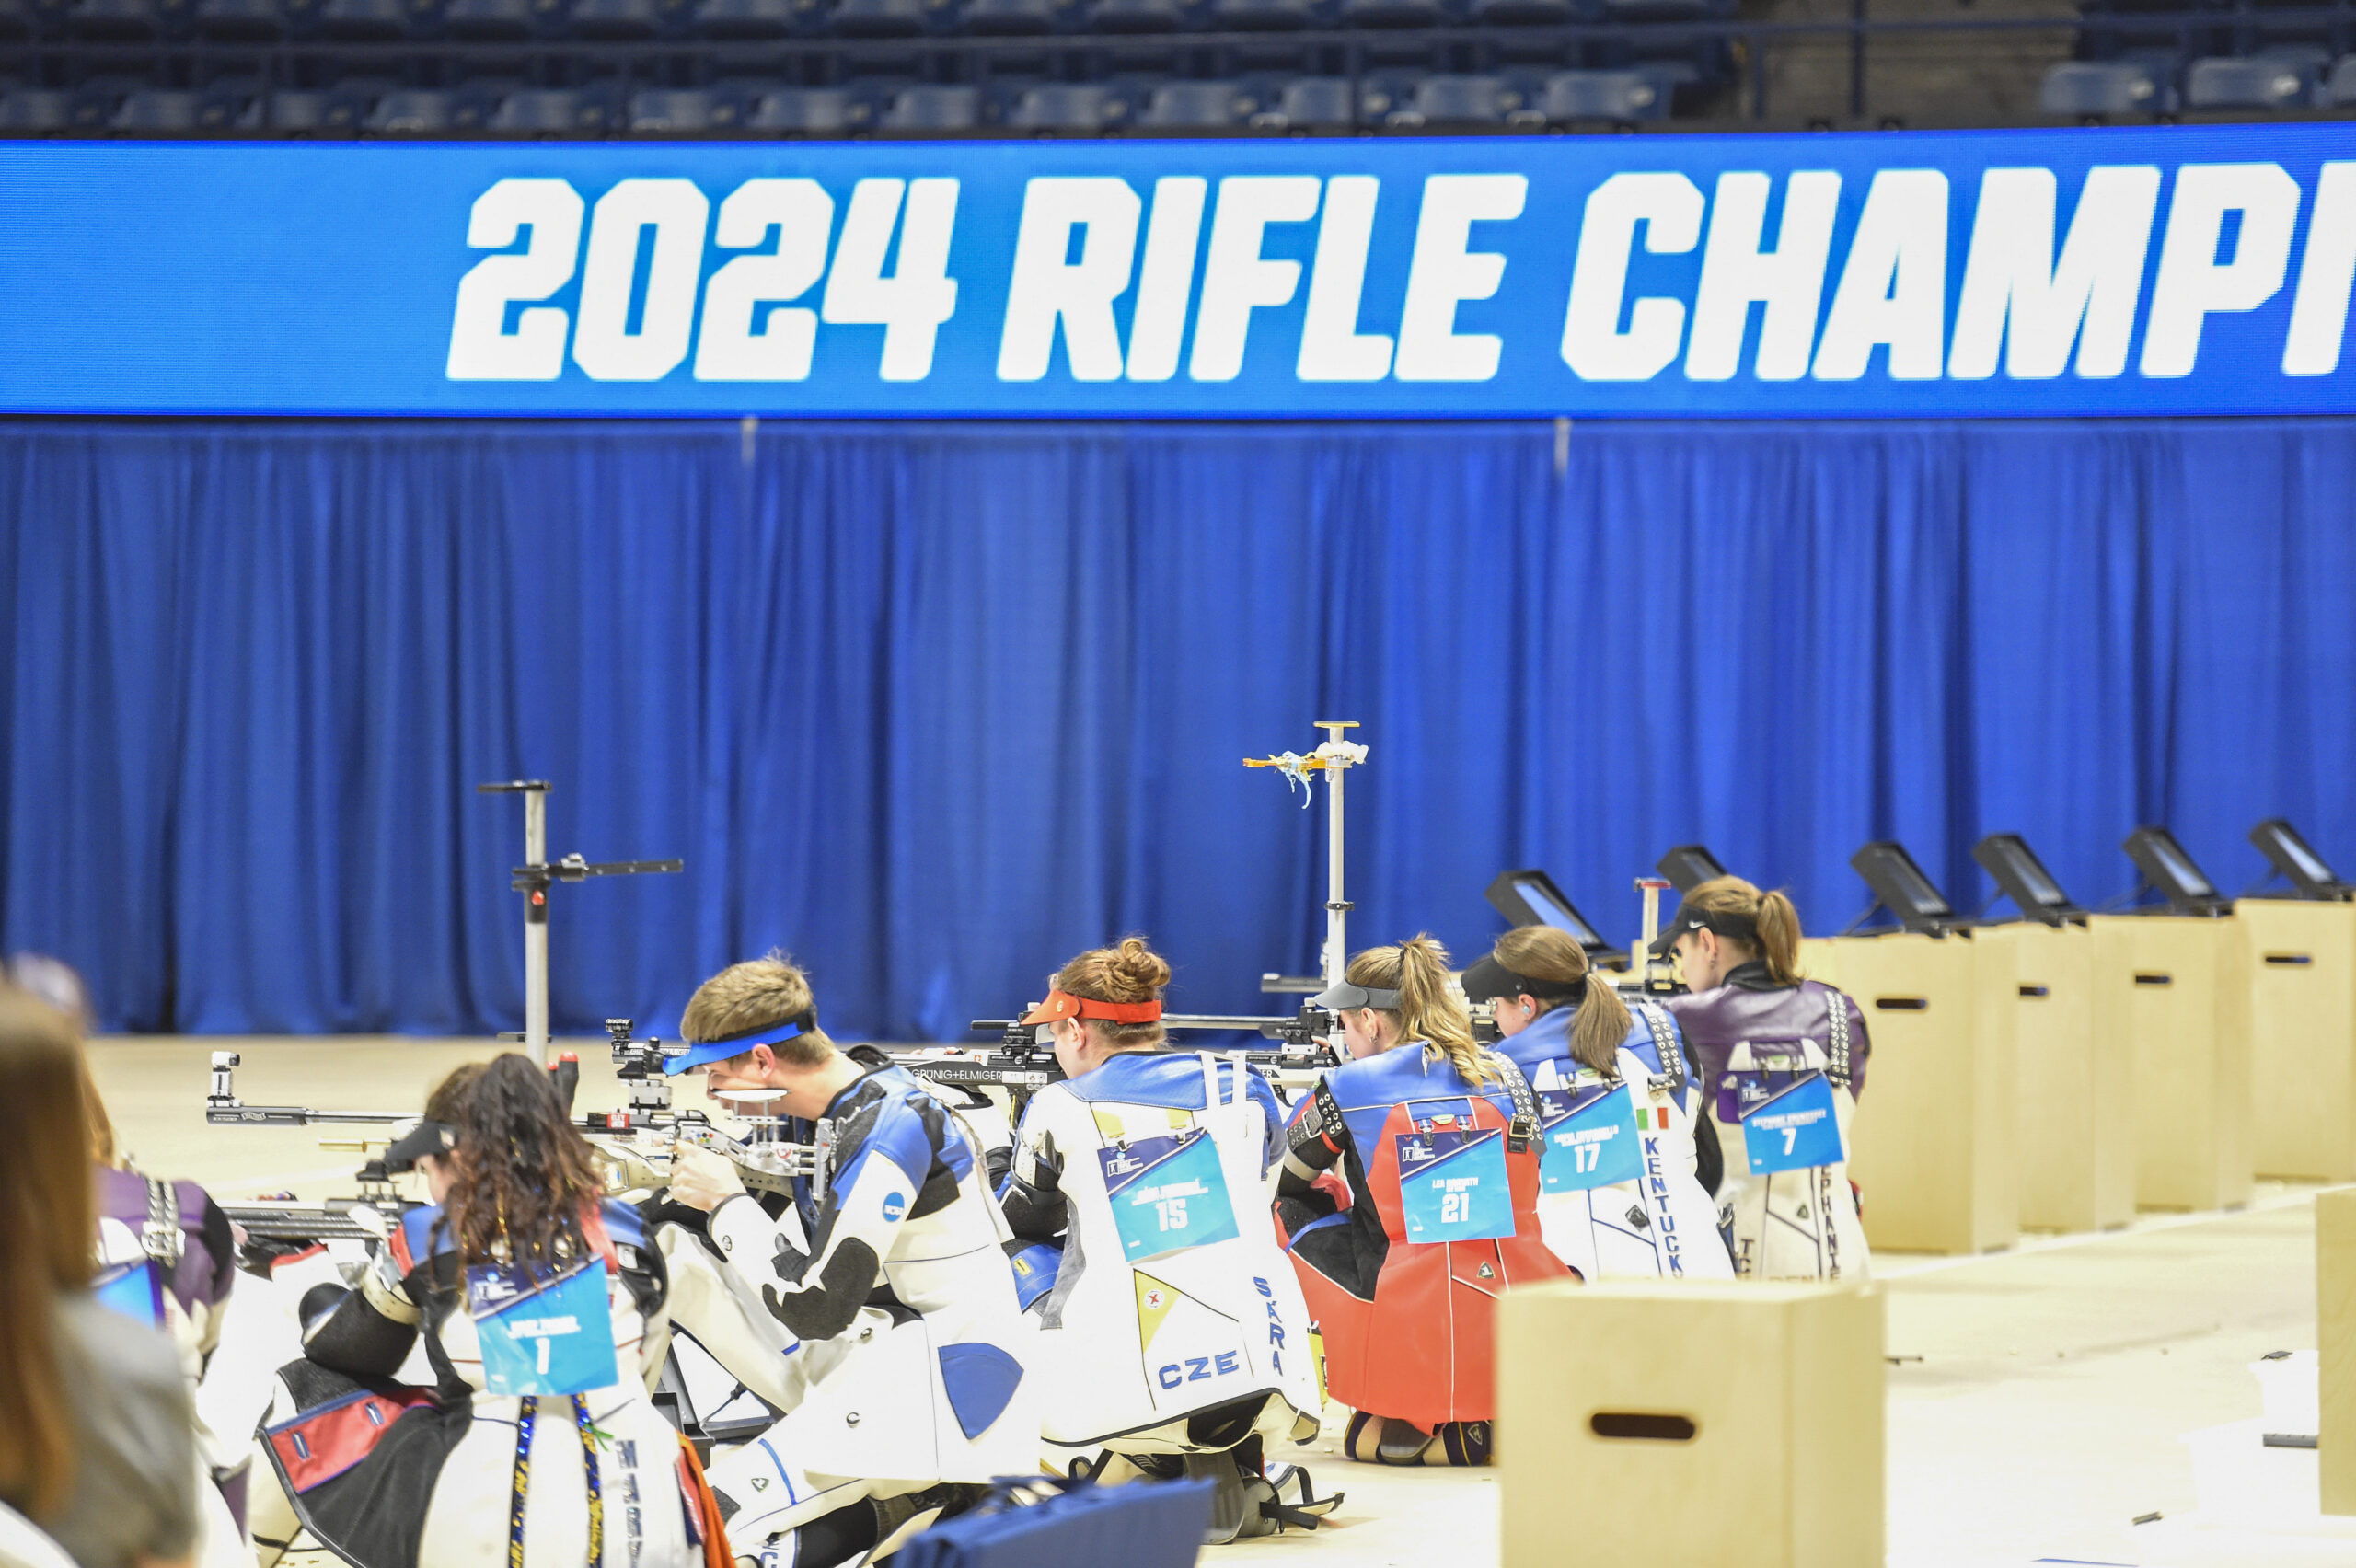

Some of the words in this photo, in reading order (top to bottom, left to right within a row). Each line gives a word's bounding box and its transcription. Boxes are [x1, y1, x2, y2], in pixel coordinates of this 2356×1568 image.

[448, 179, 958, 380] 2024
[999, 176, 1527, 380] RIFLE
[1563, 163, 2356, 379] CHAMPI
[1575, 1142, 1600, 1174] 17
[1782, 1127, 1796, 1156] 7
[1156, 1197, 1189, 1232] 15
[1441, 1193, 1470, 1224] 21
[536, 1337, 550, 1375] 1
[1159, 1350, 1240, 1390] CZE
